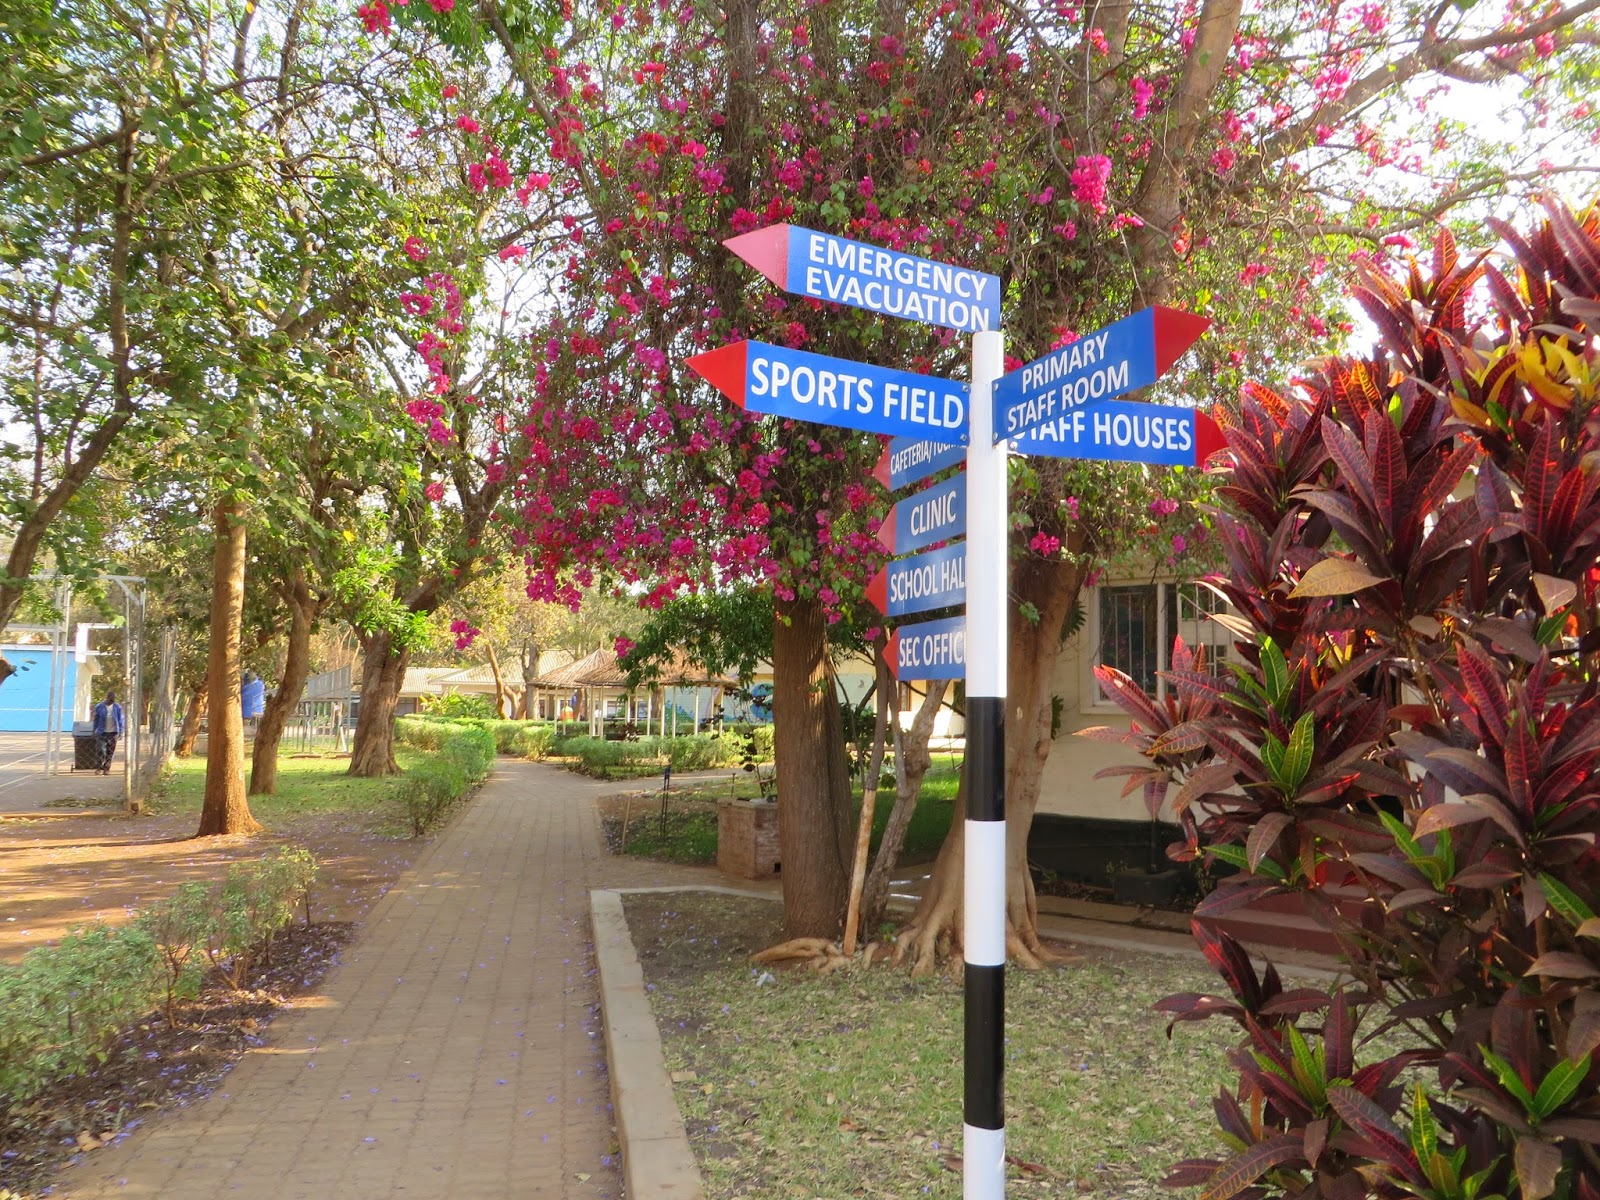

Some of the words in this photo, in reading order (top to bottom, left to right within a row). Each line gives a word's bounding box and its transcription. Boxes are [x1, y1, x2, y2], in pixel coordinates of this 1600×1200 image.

[806, 266, 990, 331] EVACUATION
[809, 234, 987, 301] EMERGENCY
[751, 357, 874, 414] SPORTS
[883, 383, 964, 429] FIELD
[1022, 331, 1109, 394] PRIMARY
[1007, 389, 1057, 432] STAFF
[1062, 360, 1129, 411] ROOM
[1013, 411, 1086, 443] AFF
[1094, 412, 1192, 451] HOUSES
[910, 490, 957, 536] CLINIC
[890, 564, 938, 603] SCHOOL
[941, 556, 966, 592] HAL
[899, 636, 920, 667] SEC
